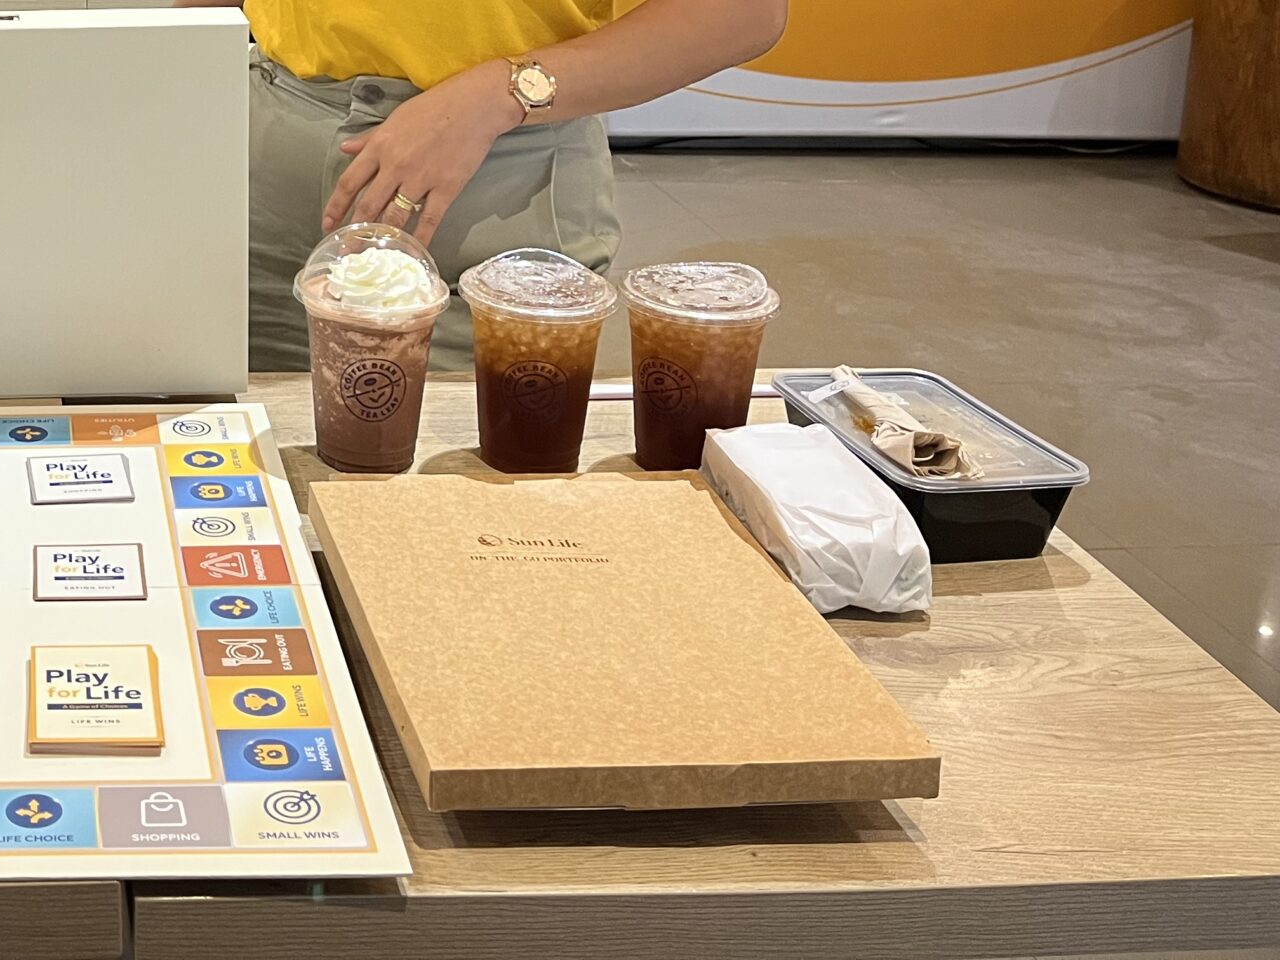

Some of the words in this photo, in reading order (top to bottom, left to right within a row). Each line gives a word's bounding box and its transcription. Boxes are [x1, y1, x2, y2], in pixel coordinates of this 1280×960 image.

[360, 409, 378, 419] TEA
[46, 463, 88, 472] Play
[74, 470, 112, 480] Life
[507, 537, 544, 547] Sun
[548, 538, 582, 548] Life
[53, 553, 100, 566] Play
[82, 564, 124, 574] Life
[263, 590, 276, 611] CHOICE
[267, 612, 280, 624] LIFE
[274, 634, 289, 647] OUT
[278, 647, 293, 671] EATING
[46, 669, 108, 686] Play
[47, 686, 80, 698] for
[86, 685, 142, 700] Life
[292, 684, 304, 702] WINS
[296, 702, 308, 717] LIFE
[304, 746, 318, 762] LIFE
[315, 736, 333, 772] HAPPENS
[24, 834, 74, 843] CHOICE
[131, 832, 201, 842] SHOPPING
[258, 831, 300, 840] SMALL
[302, 830, 340, 839] WINS
